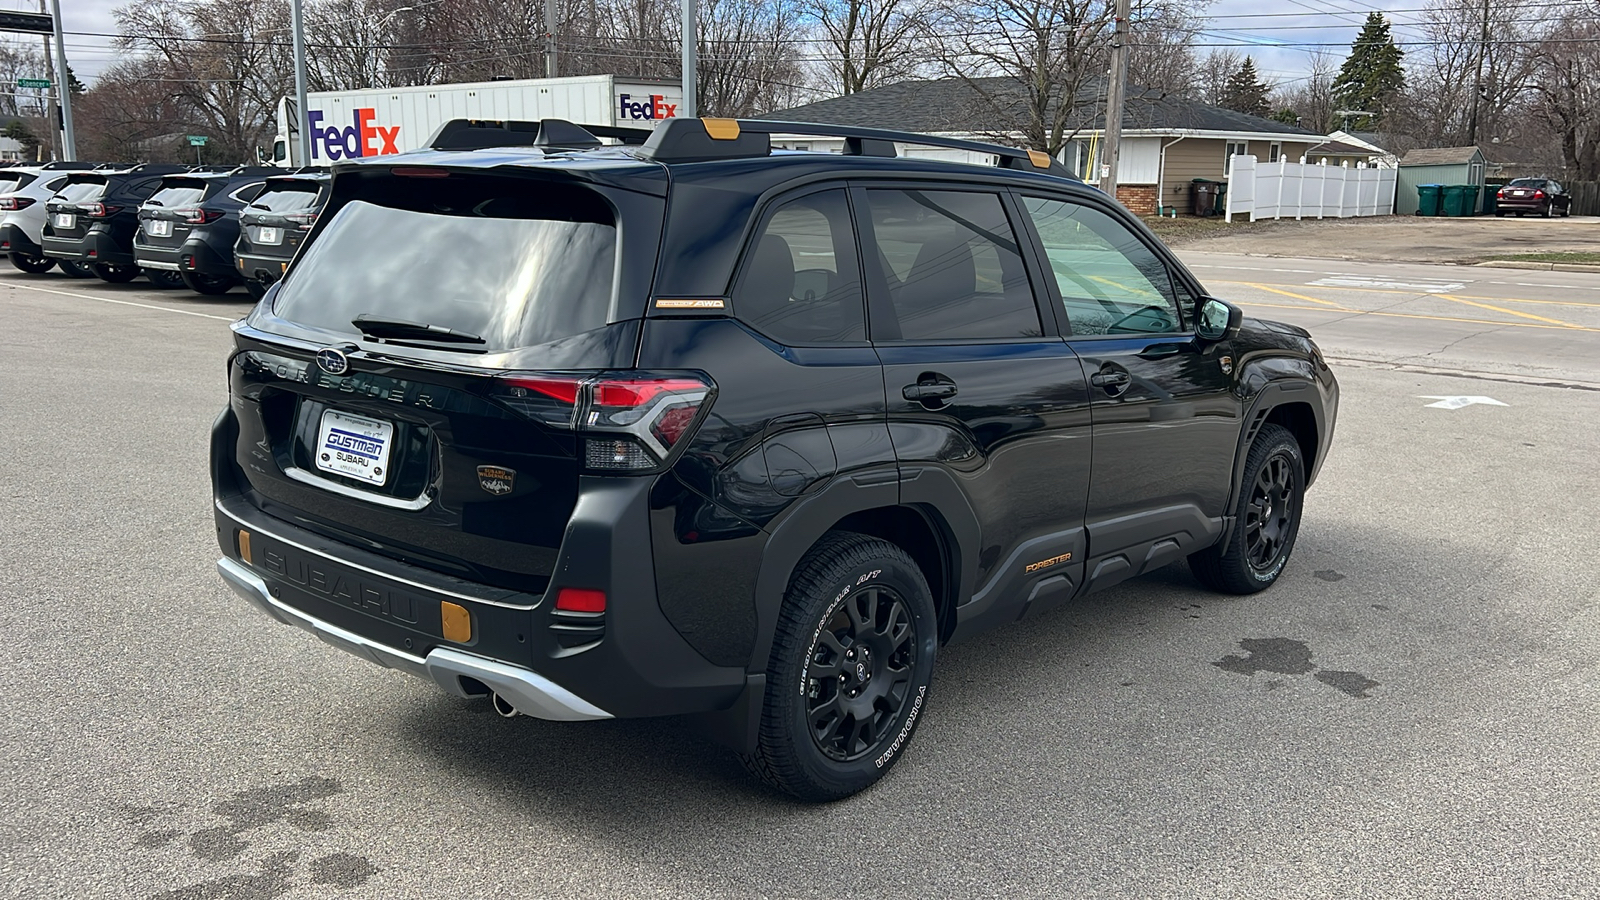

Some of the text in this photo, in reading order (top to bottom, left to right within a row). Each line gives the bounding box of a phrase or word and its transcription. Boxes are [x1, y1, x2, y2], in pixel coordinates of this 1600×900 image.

[620, 93, 677, 120] FedEx
[308, 108, 400, 161] FedEx
[336, 451, 370, 468] SUBARU
[1025, 552, 1072, 574] FORESTER
[264, 547, 419, 625] SUBARU
[875, 685, 927, 769] YOKOHAMA
